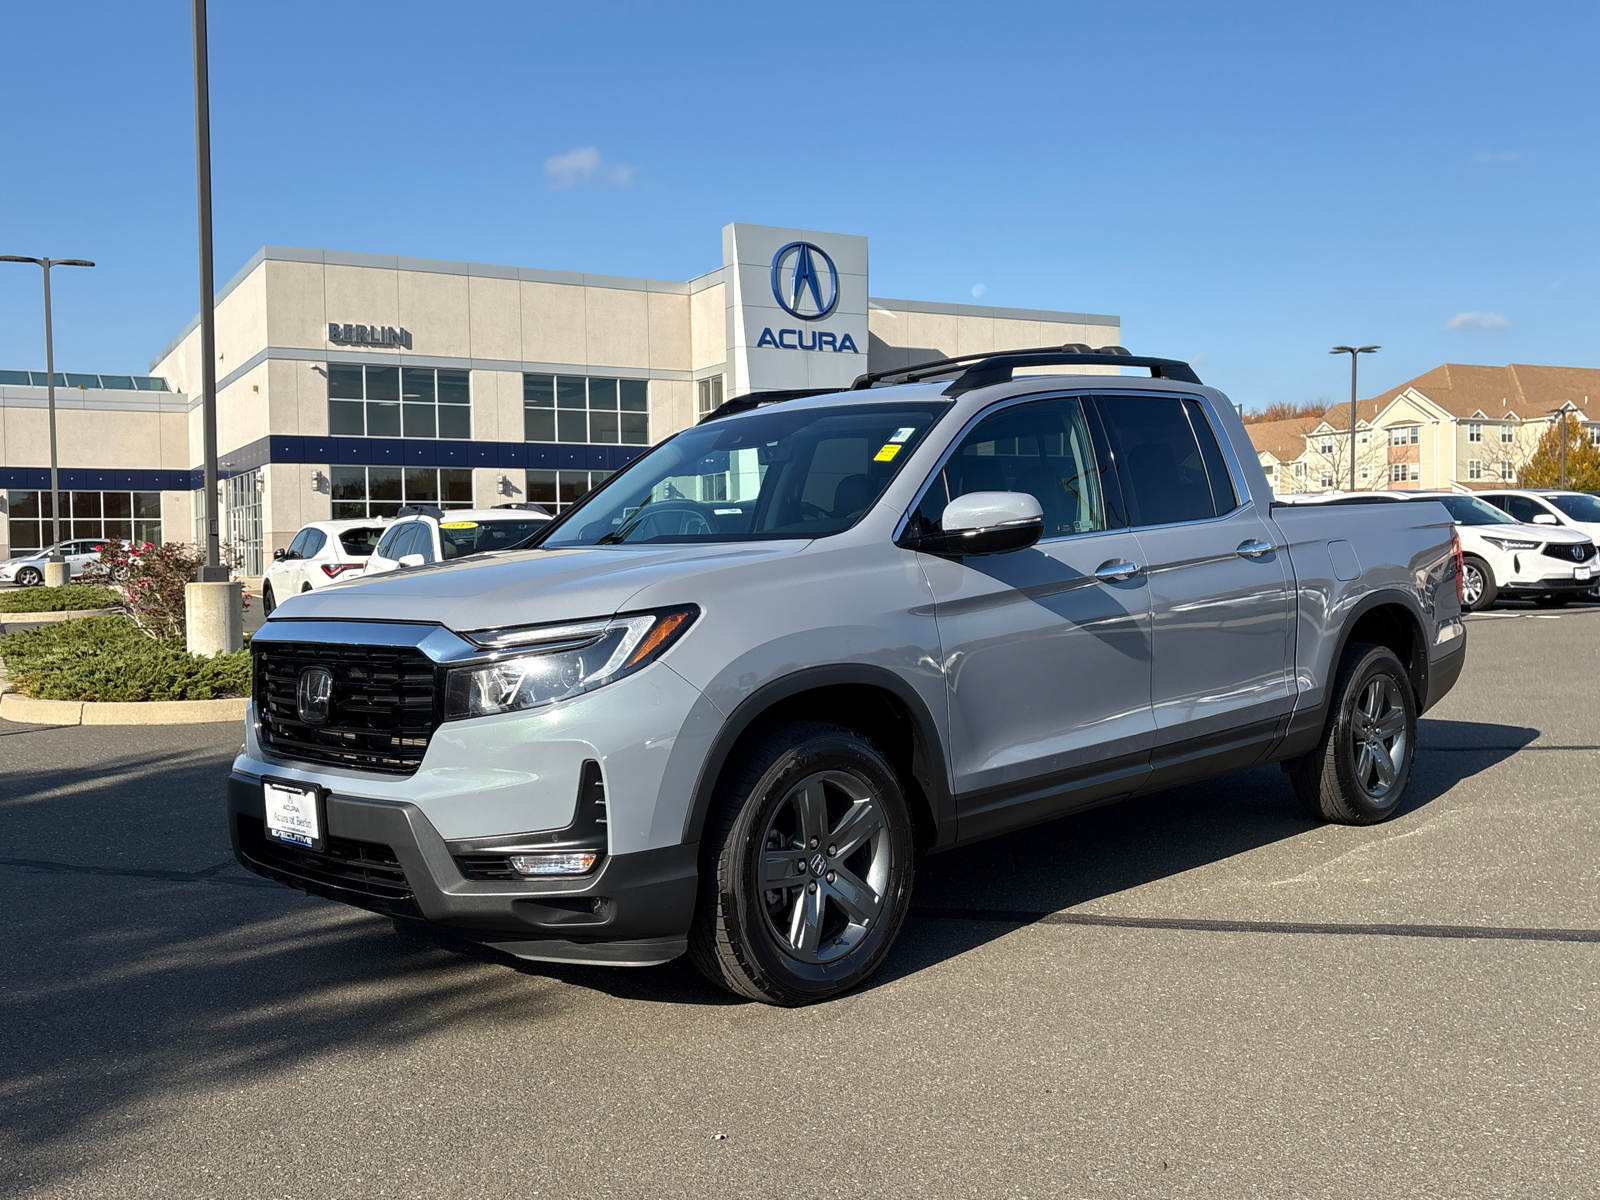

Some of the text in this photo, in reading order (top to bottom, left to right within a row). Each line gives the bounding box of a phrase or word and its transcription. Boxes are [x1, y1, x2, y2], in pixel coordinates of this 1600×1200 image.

[328, 322, 405, 345] BERLIN
[757, 327, 859, 354] ACURA
[282, 804, 300, 813] ACURA
[273, 811, 289, 824] Acura
[296, 815, 312, 829] Berlin
[271, 829, 312, 845] EXECUTIVE
